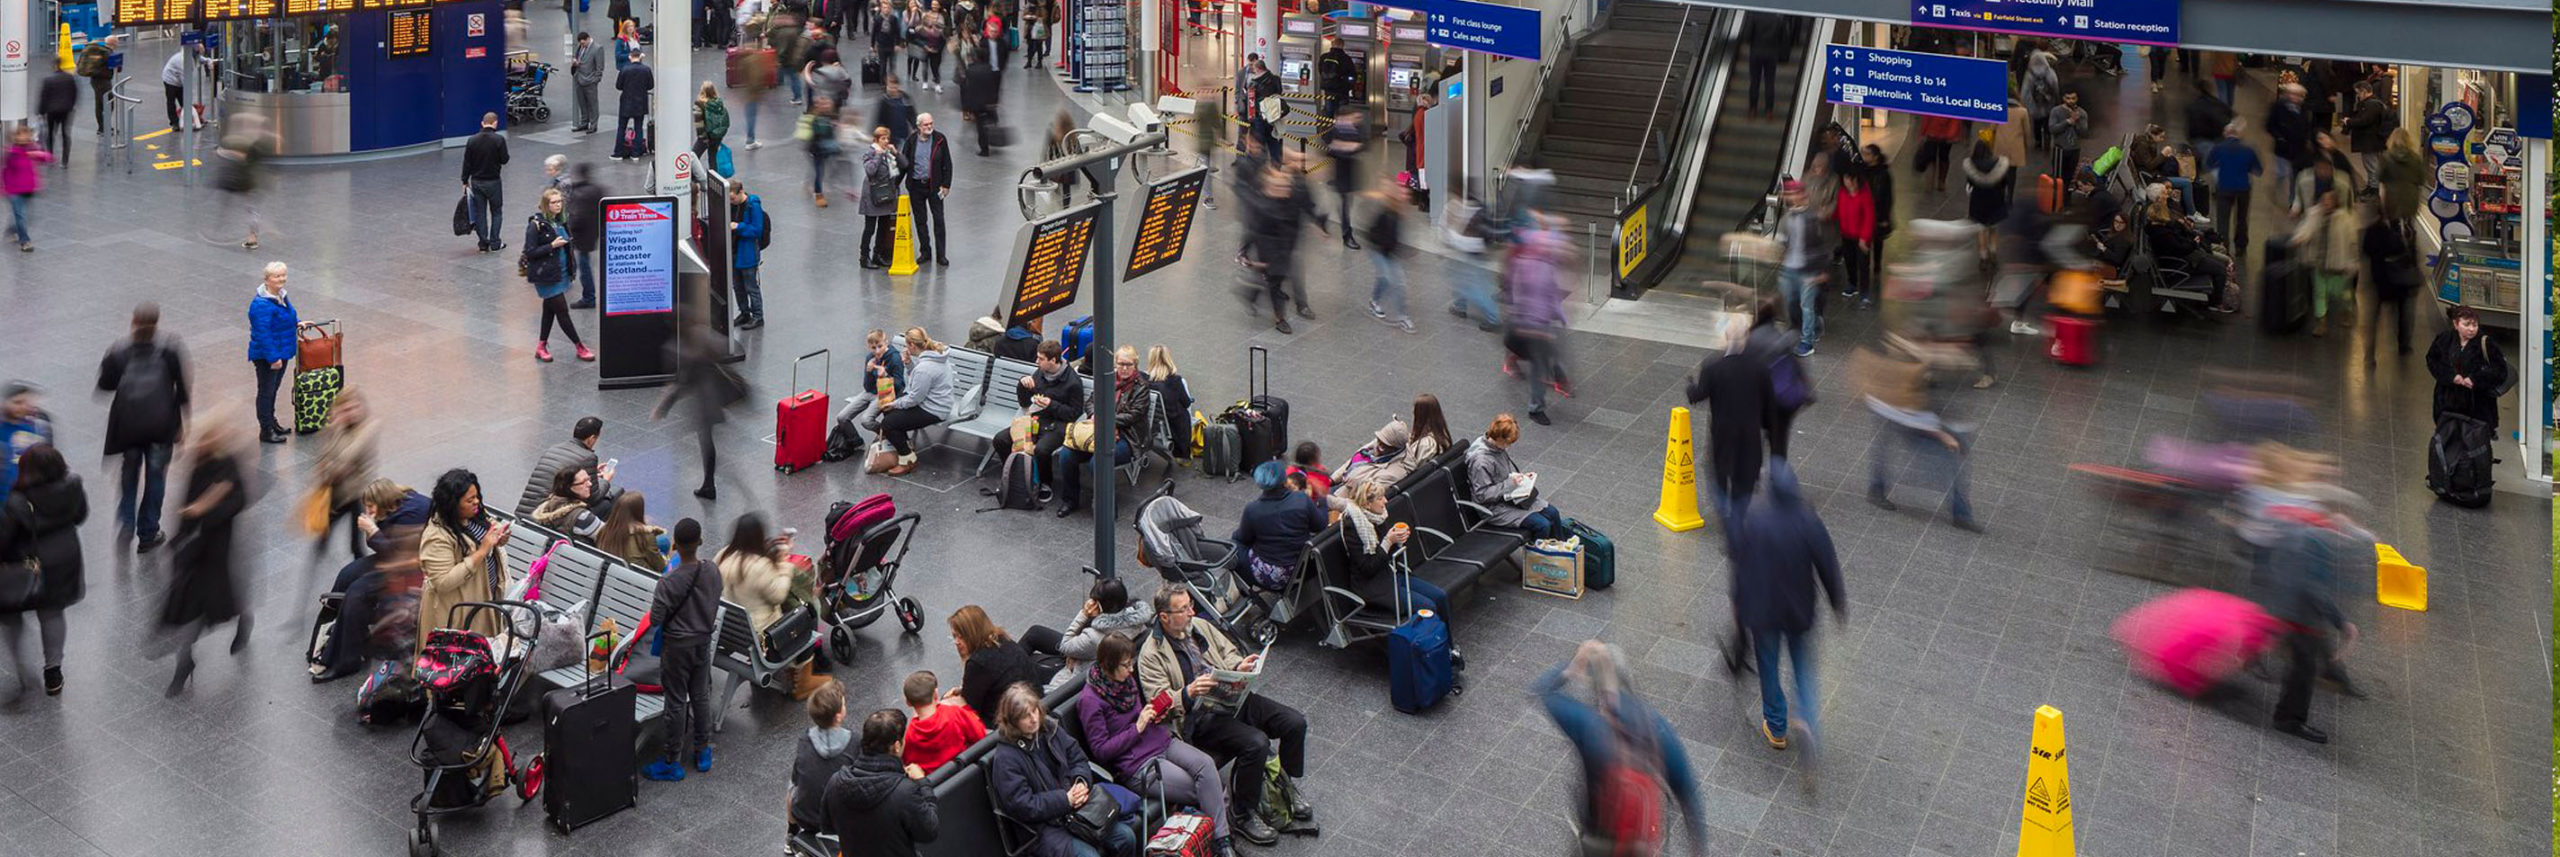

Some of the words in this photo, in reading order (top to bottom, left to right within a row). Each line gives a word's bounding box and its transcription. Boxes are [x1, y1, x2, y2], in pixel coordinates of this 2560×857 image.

[2007, 0, 2061, 8] cadilly
[2067, 0, 2094, 8] Mall
[1950, 8, 1971, 18] Taxis
[1993, 14, 2015, 22] Fairfield
[1452, 16, 1466, 26] First
[1466, 19, 1481, 28] class
[1481, 21, 1502, 33] lounge
[2094, 19, 2126, 30] Station
[2127, 23, 2170, 33] reception
[1470, 35, 1481, 43] and
[1481, 35, 1495, 46] bars
[1868, 52, 1912, 68] Shopping
[1868, 69, 1912, 84] Platforms
[1914, 74, 1922, 85] 8
[1923, 76, 1934, 86] to
[1935, 77, 1947, 87] 14
[1868, 87, 1912, 101] Metrolink
[1920, 92, 1944, 105] Taxis
[1945, 95, 1972, 108] Local
[1973, 98, 2003, 112] Buses
[620, 213, 638, 221] Train
[639, 212, 658, 220] Times
[608, 236, 637, 245] Wigan
[608, 244, 642, 252] Preston
[608, 252, 651, 261] Lancaster
[608, 265, 647, 275] Scotland
